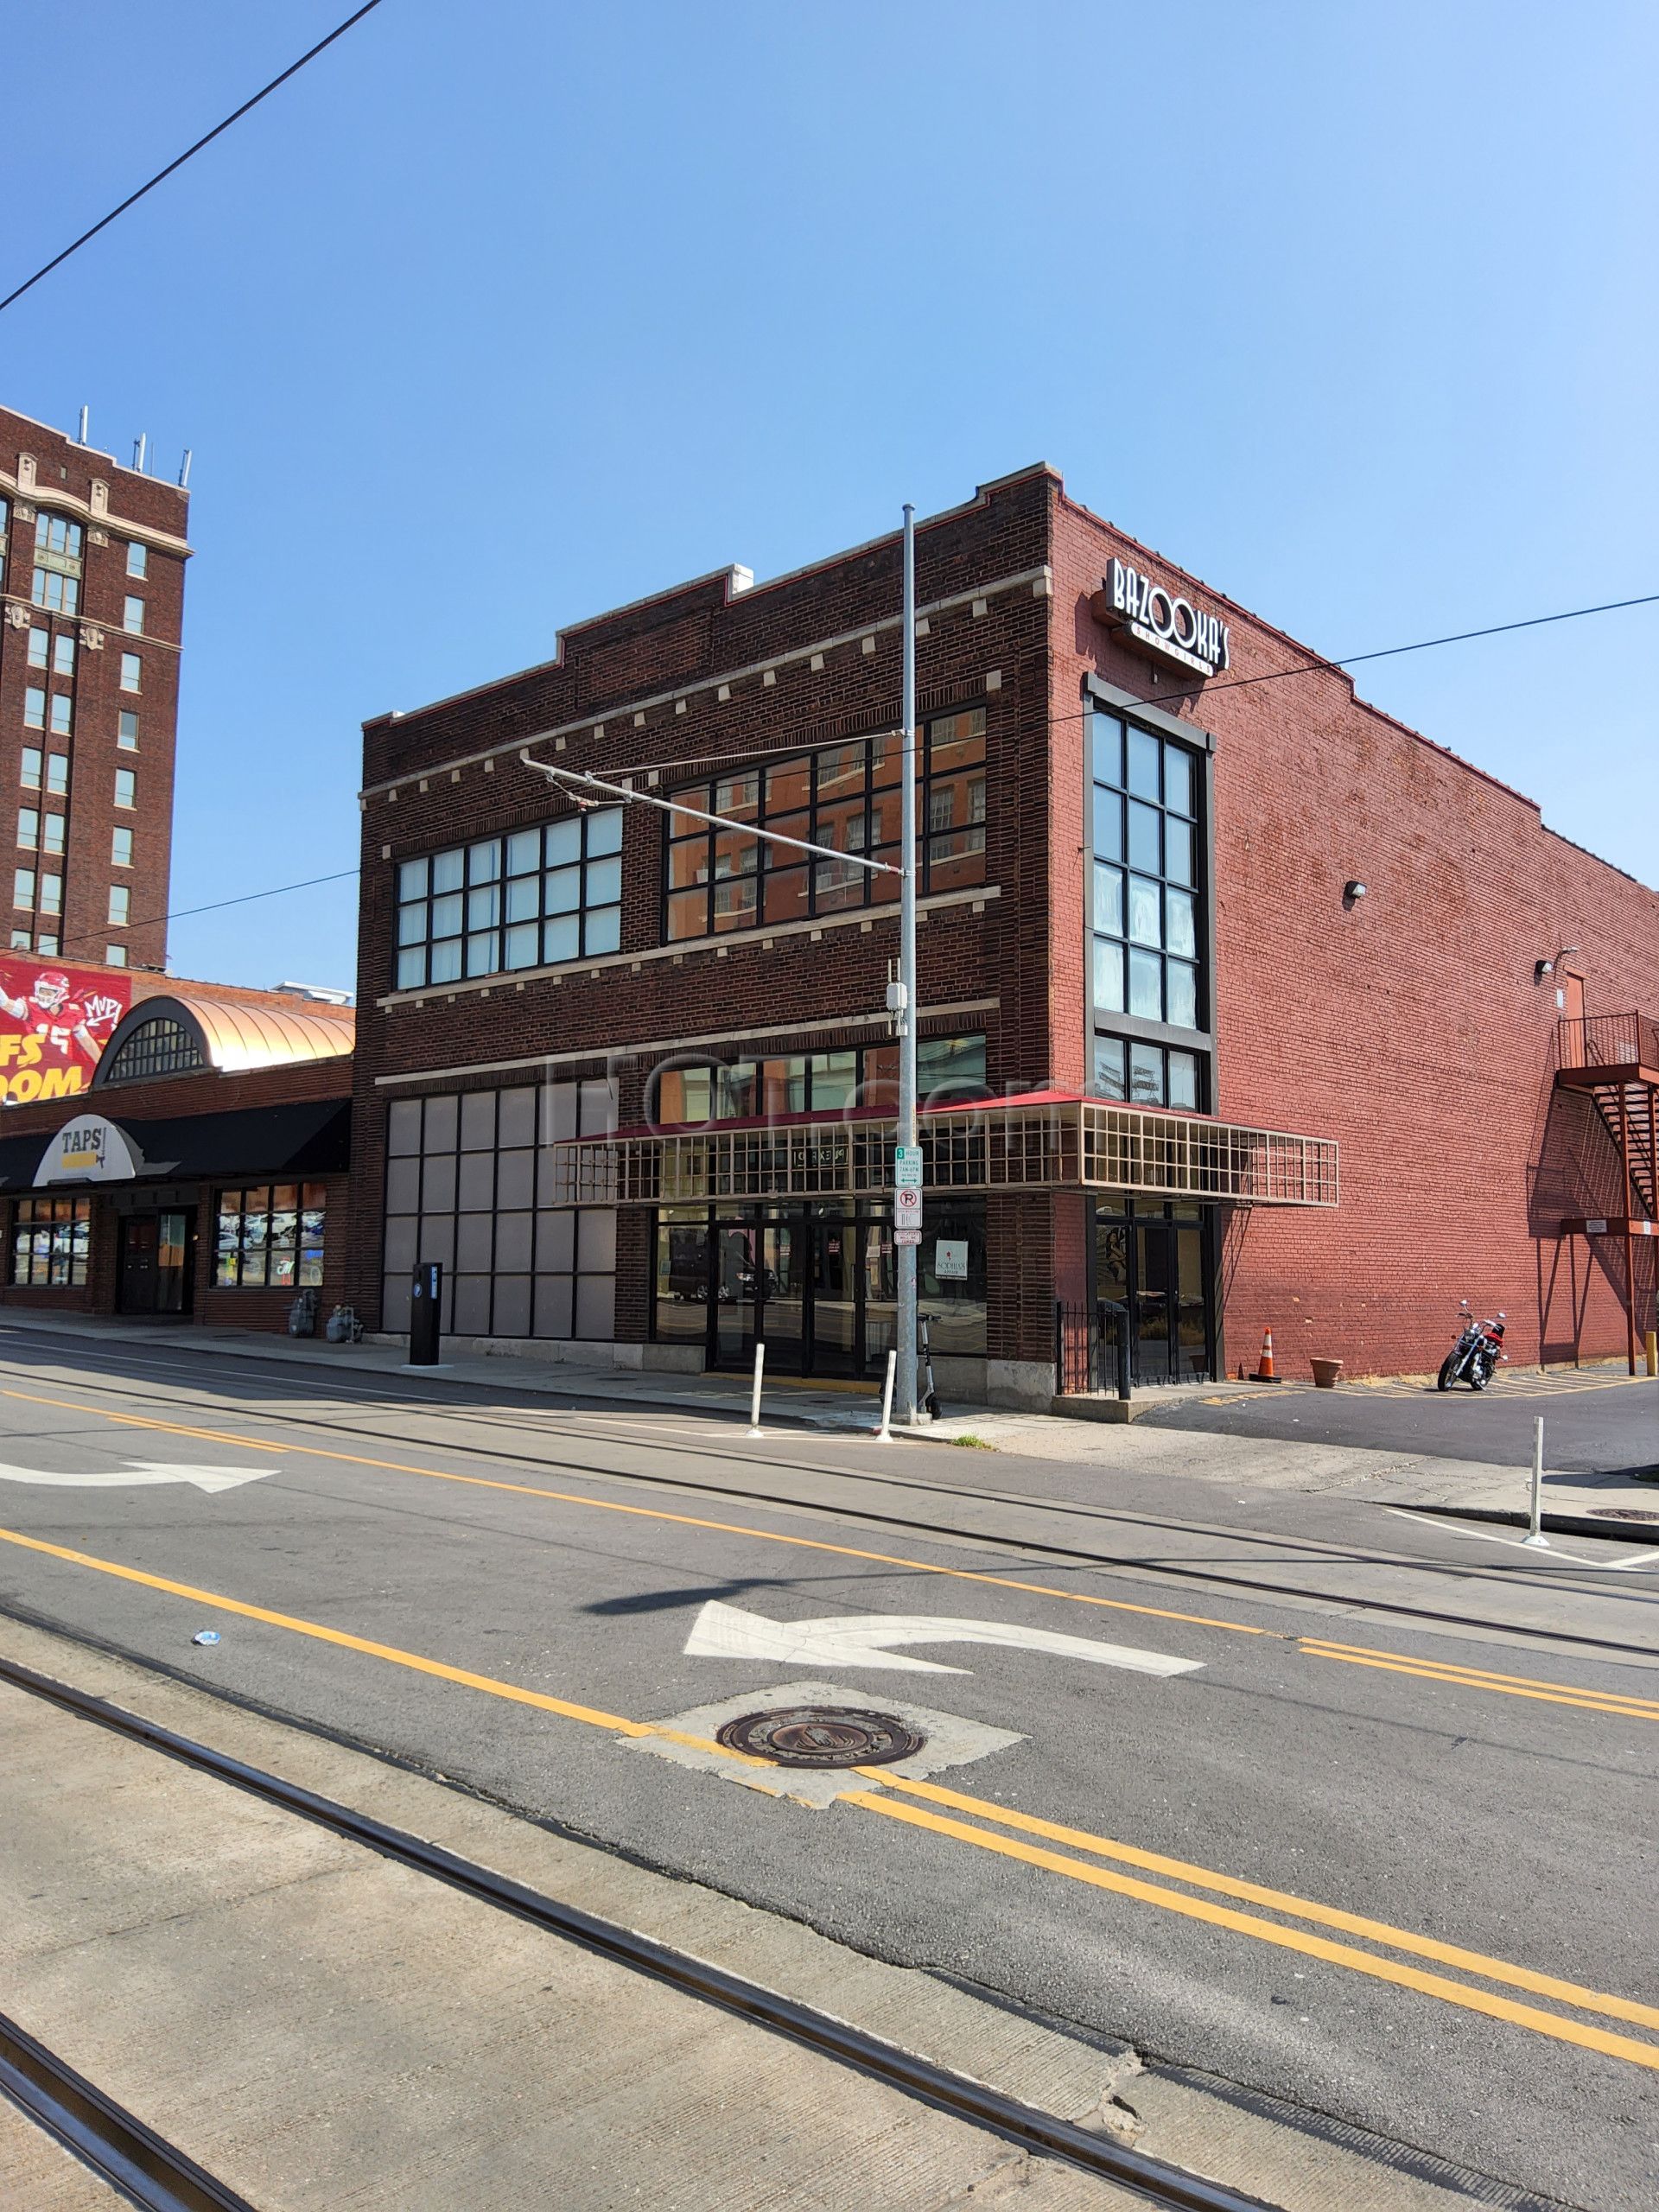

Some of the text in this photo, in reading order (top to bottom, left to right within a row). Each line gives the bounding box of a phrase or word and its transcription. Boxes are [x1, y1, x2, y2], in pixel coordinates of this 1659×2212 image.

[1114, 557, 1230, 670] BAZOOKA'S
[1135, 626, 1211, 674] SHOWGIRLS
[85, 995, 123, 1031] MVP!
[0, 1066, 82, 1103] OM
[898, 1149, 903, 1158] 3
